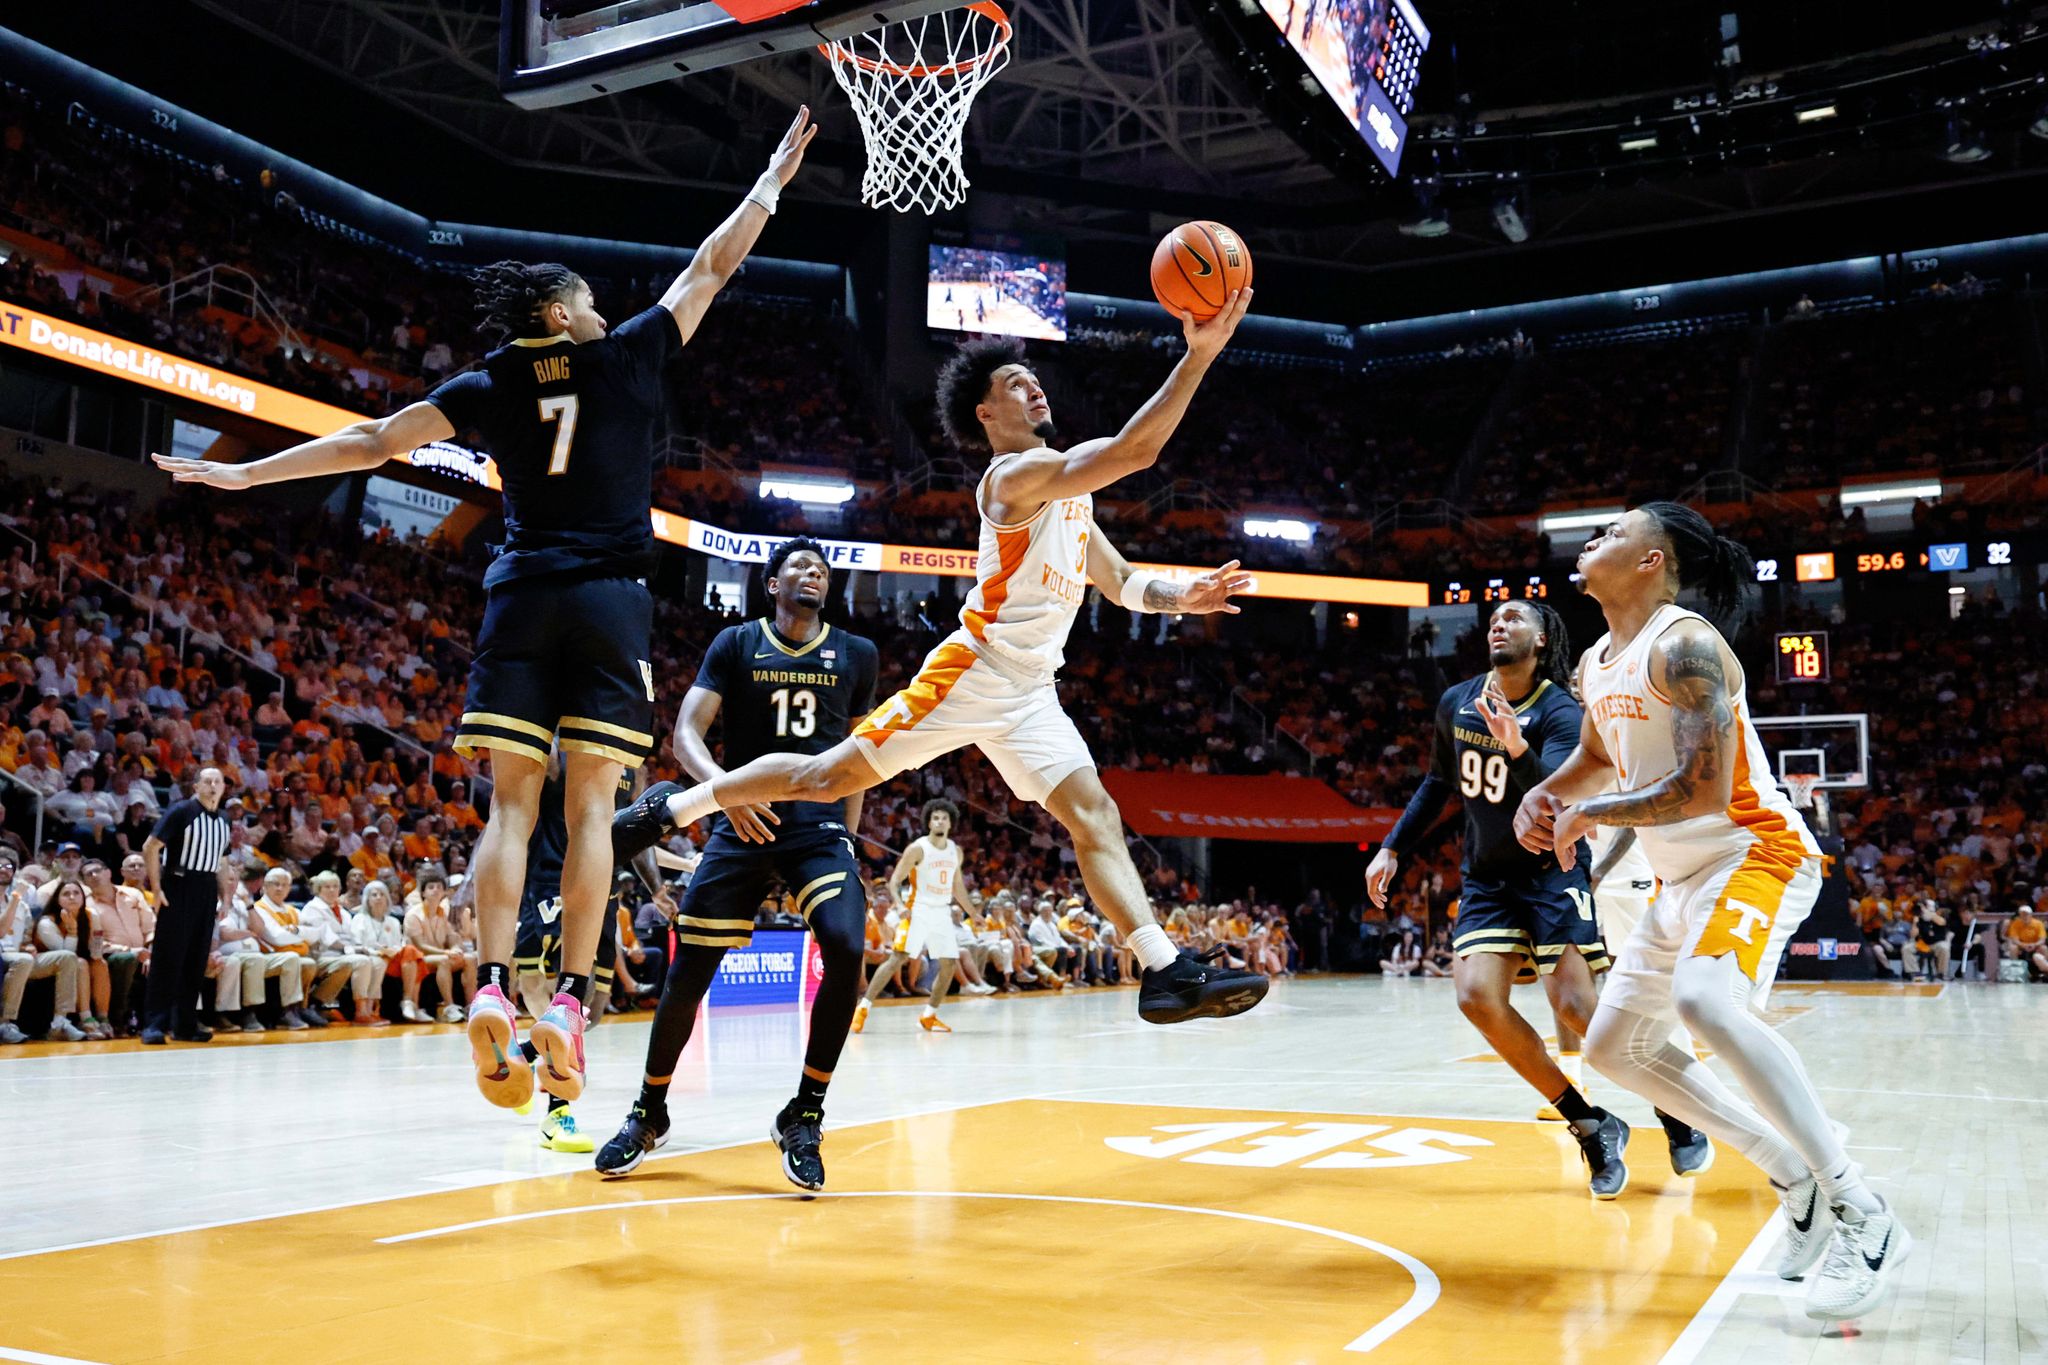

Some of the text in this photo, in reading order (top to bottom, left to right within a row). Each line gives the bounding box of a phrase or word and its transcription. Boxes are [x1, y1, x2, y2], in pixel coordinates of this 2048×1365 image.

[151, 108, 177, 132] 324
[428, 230, 465, 246] 325A
[1094, 304, 1117, 319] 327
[1634, 295, 1660, 310] 328
[29, 318, 257, 412] DonateLifeTN.org
[533, 355, 570, 383] BING
[537, 393, 580, 476] 7
[411, 447, 489, 488] SHOWDOWN
[702, 529, 865, 563] DONAT IFE
[1075, 531, 1088, 574] 3
[1935, 547, 1961, 567] V
[1986, 542, 2012, 565] 32
[899, 551, 979, 570] REGISTE
[1756, 559, 1778, 581] 22
[1802, 556, 1828, 580] T
[1857, 552, 1906, 573] 59.6
[1795, 650, 1821, 677] 18
[752, 670, 838, 687] VANDERBILT
[770, 688, 817, 738] 13
[1460, 749, 1509, 804] 99
[940, 870, 947, 884] 0
[1564, 888, 1594, 921] V
[1726, 897, 1770, 945] T
[720, 953, 760, 974] PIGEON
[761, 952, 795, 972] FORGE
[722, 972, 794, 984] TENNESSEE
